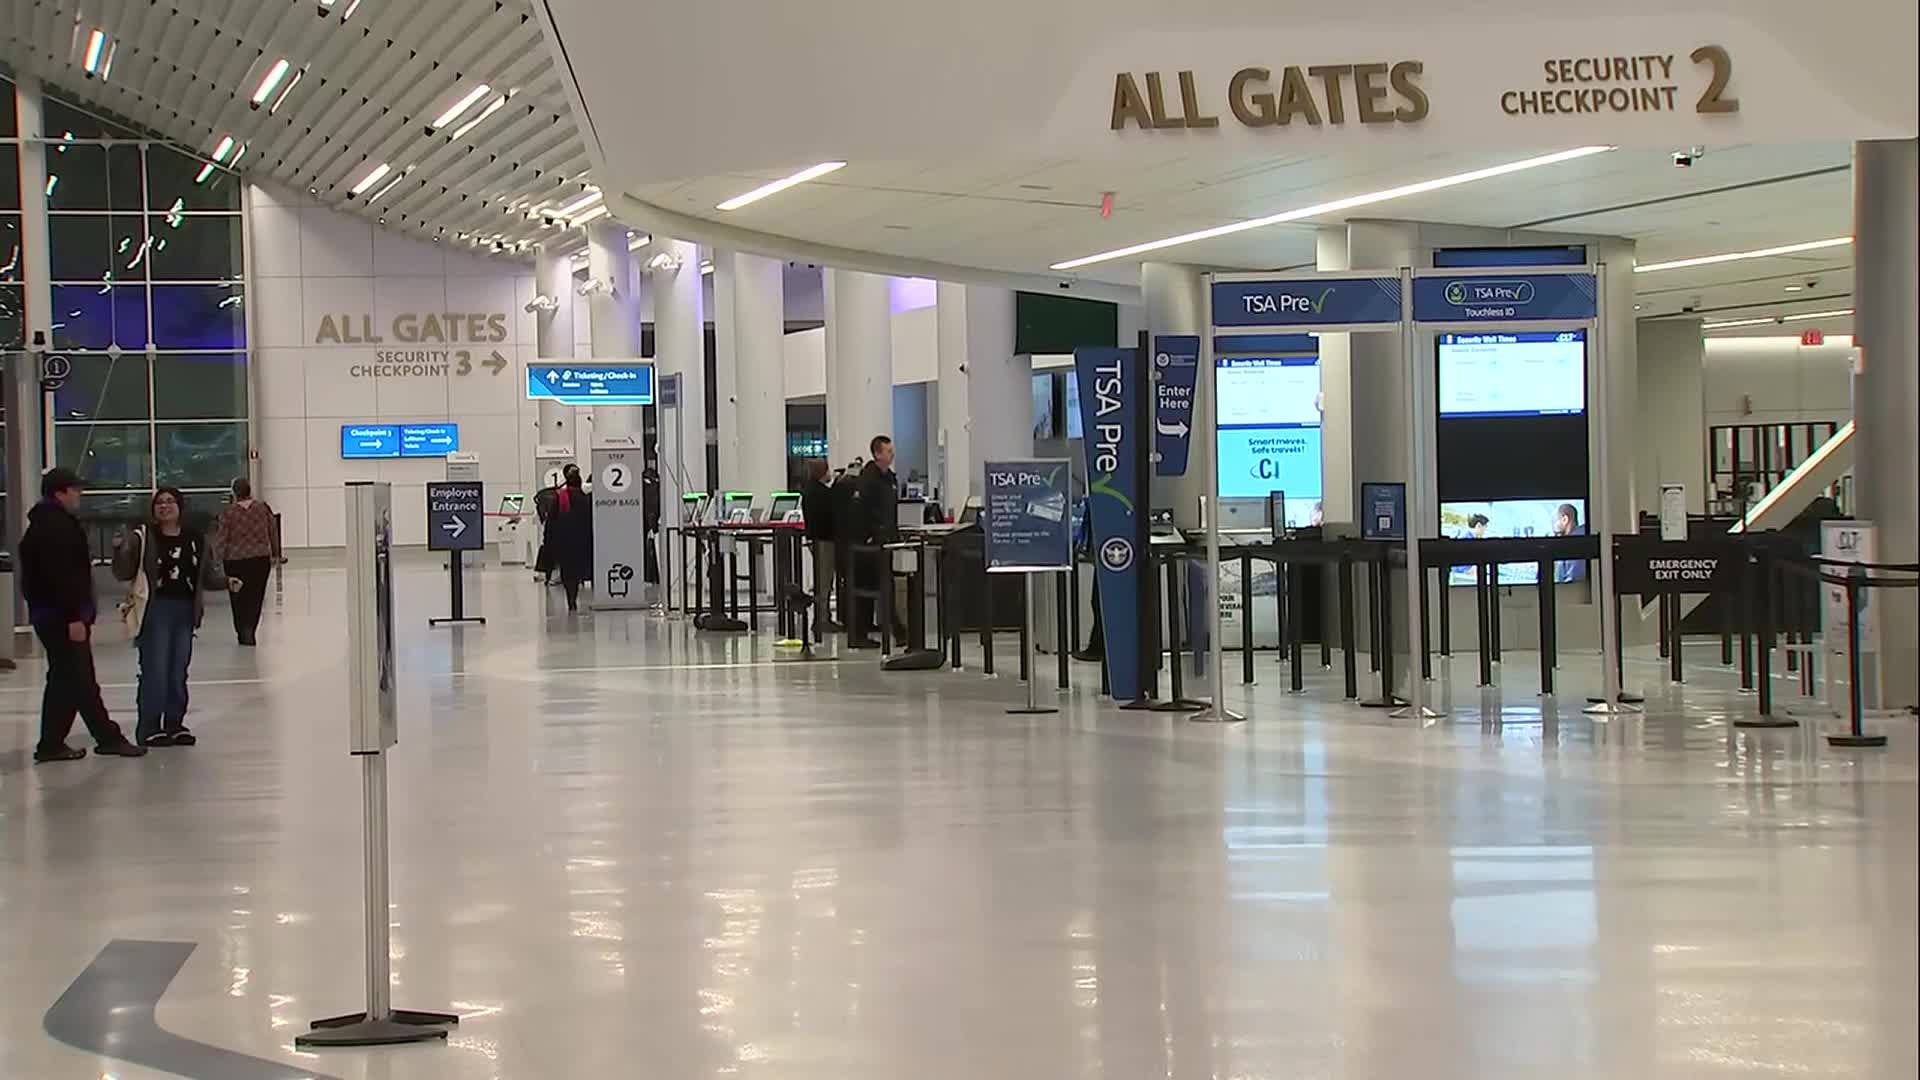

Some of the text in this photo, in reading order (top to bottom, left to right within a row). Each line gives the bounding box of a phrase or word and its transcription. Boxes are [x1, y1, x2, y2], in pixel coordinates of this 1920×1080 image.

[1544, 44, 1740, 114] SECURITY 2
[1110, 60, 1429, 129] ALL GATES
[1500, 86, 1678, 115] CHECKPOINT
[1475, 287, 1512, 298] TSA Pre
[1242, 294, 1309, 313] TSA Pre
[1465, 307, 1515, 317] Touchless ID
[315, 313, 508, 344] ALL GATES
[376, 350, 472, 376] SECURITY 3
[350, 364, 450, 377] CHECKPOINT
[1158, 385, 1191, 397] Enter
[1160, 397, 1190, 409] Here
[1095, 359, 1122, 473] TSA Pre
[1248, 438, 1274, 446] Smart
[551, 472, 558, 488] 1
[611, 468, 624, 487] 2
[990, 472, 1041, 486] TSA Pre
[430, 488, 479, 499] Employee
[432, 501, 478, 511] Entrance
[1649, 559, 1718, 570] EMERGENCY
[1655, 569, 1713, 580] EXIT ONLY
